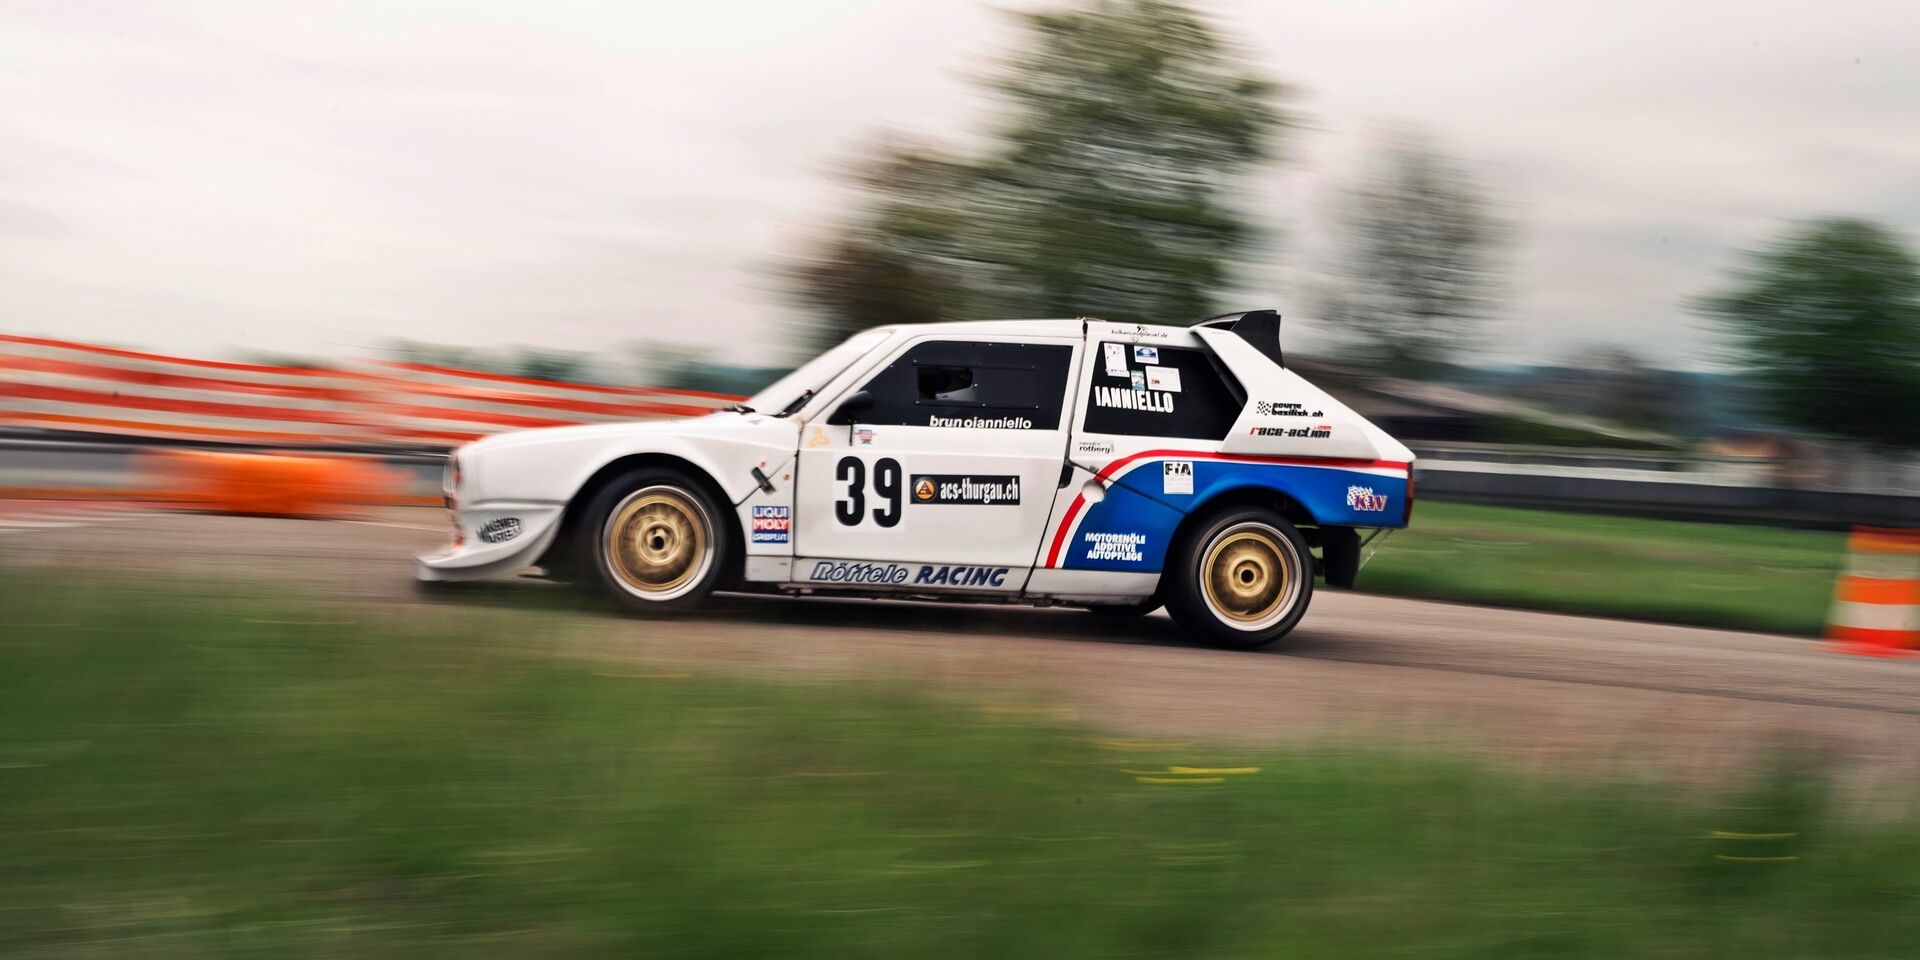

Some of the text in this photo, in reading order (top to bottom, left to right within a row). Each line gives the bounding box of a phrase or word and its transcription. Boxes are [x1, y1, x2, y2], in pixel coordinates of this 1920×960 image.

[1094, 385, 1174, 413] IANNIELLO
[834, 456, 902, 528] 39
[940, 477, 1018, 504] acs-thurgau.ch
[752, 506, 788, 518] LIQUI
[752, 518, 790, 530] MOLY
[1084, 532, 1146, 545] MOTORENÖLE
[1093, 542, 1137, 553] ADDITIVE
[1086, 550, 1143, 562] AUTOPFLEGE
[913, 565, 1009, 588] RACING
